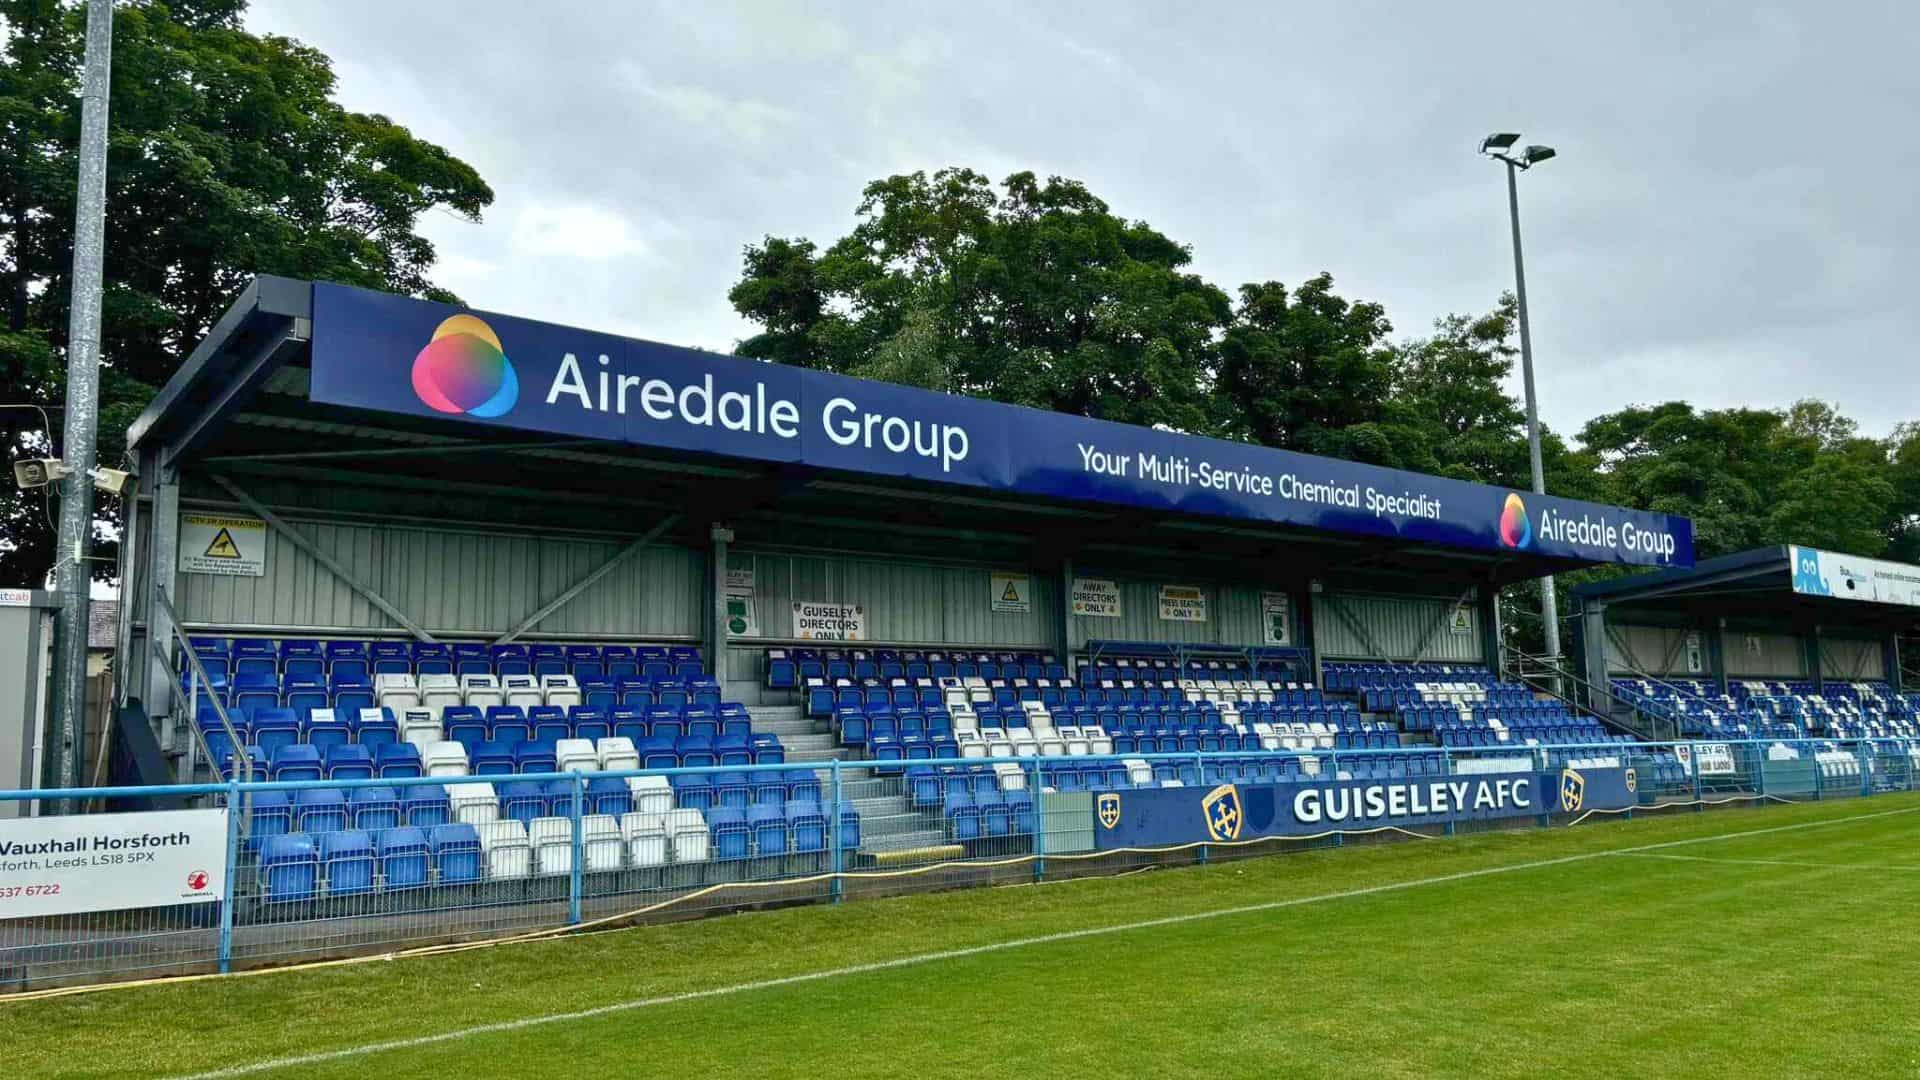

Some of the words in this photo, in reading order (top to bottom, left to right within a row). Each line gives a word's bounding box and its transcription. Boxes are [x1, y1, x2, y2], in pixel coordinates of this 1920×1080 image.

[545, 352, 800, 439] Airedale
[822, 397, 969, 472] Group
[1077, 443, 1130, 477] Your
[1139, 452, 1273, 496] Multi-Service
[1279, 474, 1360, 508] Chemical
[1366, 488, 1441, 519] Specialist
[1539, 508, 1617, 548] Airedale
[1622, 522, 1675, 561] Group
[1083, 583, 1107, 593] AWAY
[1073, 592, 1116, 603] DIRECTORS
[803, 606, 854, 618] GUISELEY
[1084, 604, 1106, 613] ONLY
[1172, 608, 1193, 617] ONLY
[799, 618, 858, 630] DIRECTORS
[815, 631, 845, 640] ONLY
[1293, 781, 1470, 823] GUISELEY
[1473, 779, 1530, 809] AFC
[0, 837, 87, 856] Vauxhall
[93, 832, 190, 850] Horsforth
[0, 860, 41, 872] forth,
[45, 856, 88, 869] Leeds
[92, 854, 124, 866] LS18
[127, 851, 155, 863] 5PX
[26, 884, 60, 896] 6722
